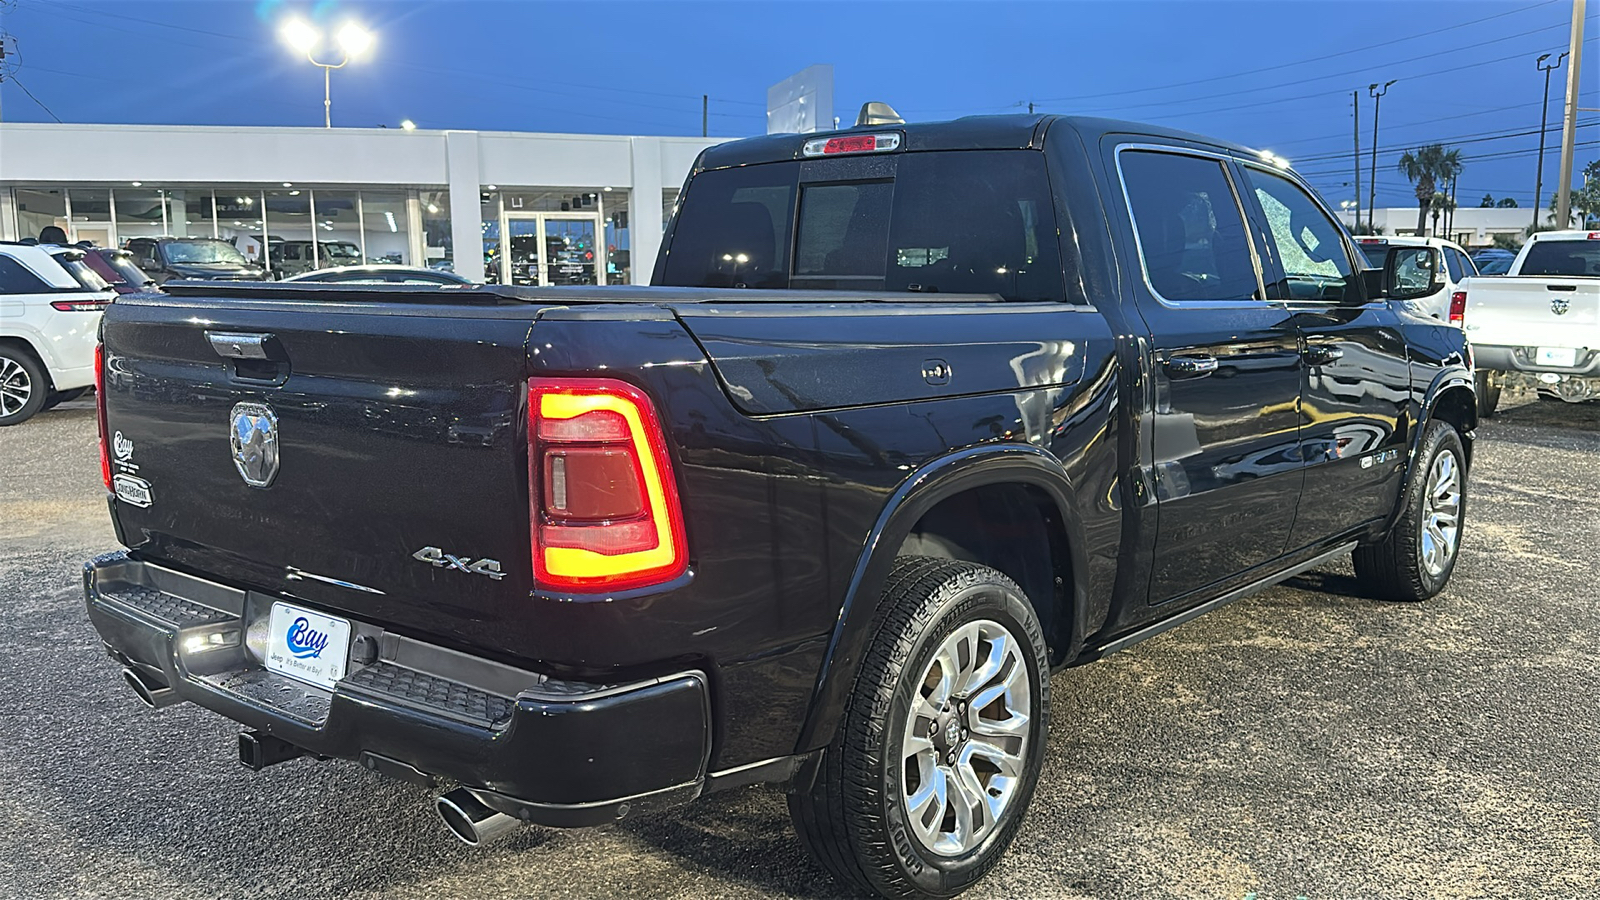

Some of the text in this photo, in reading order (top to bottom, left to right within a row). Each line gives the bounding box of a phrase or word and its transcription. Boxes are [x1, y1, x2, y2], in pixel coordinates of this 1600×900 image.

[114, 431, 134, 461] Bay
[287, 616, 329, 659] Bay
[271, 652, 284, 663] Jeep
[1023, 613, 1049, 728] WRANGLER
